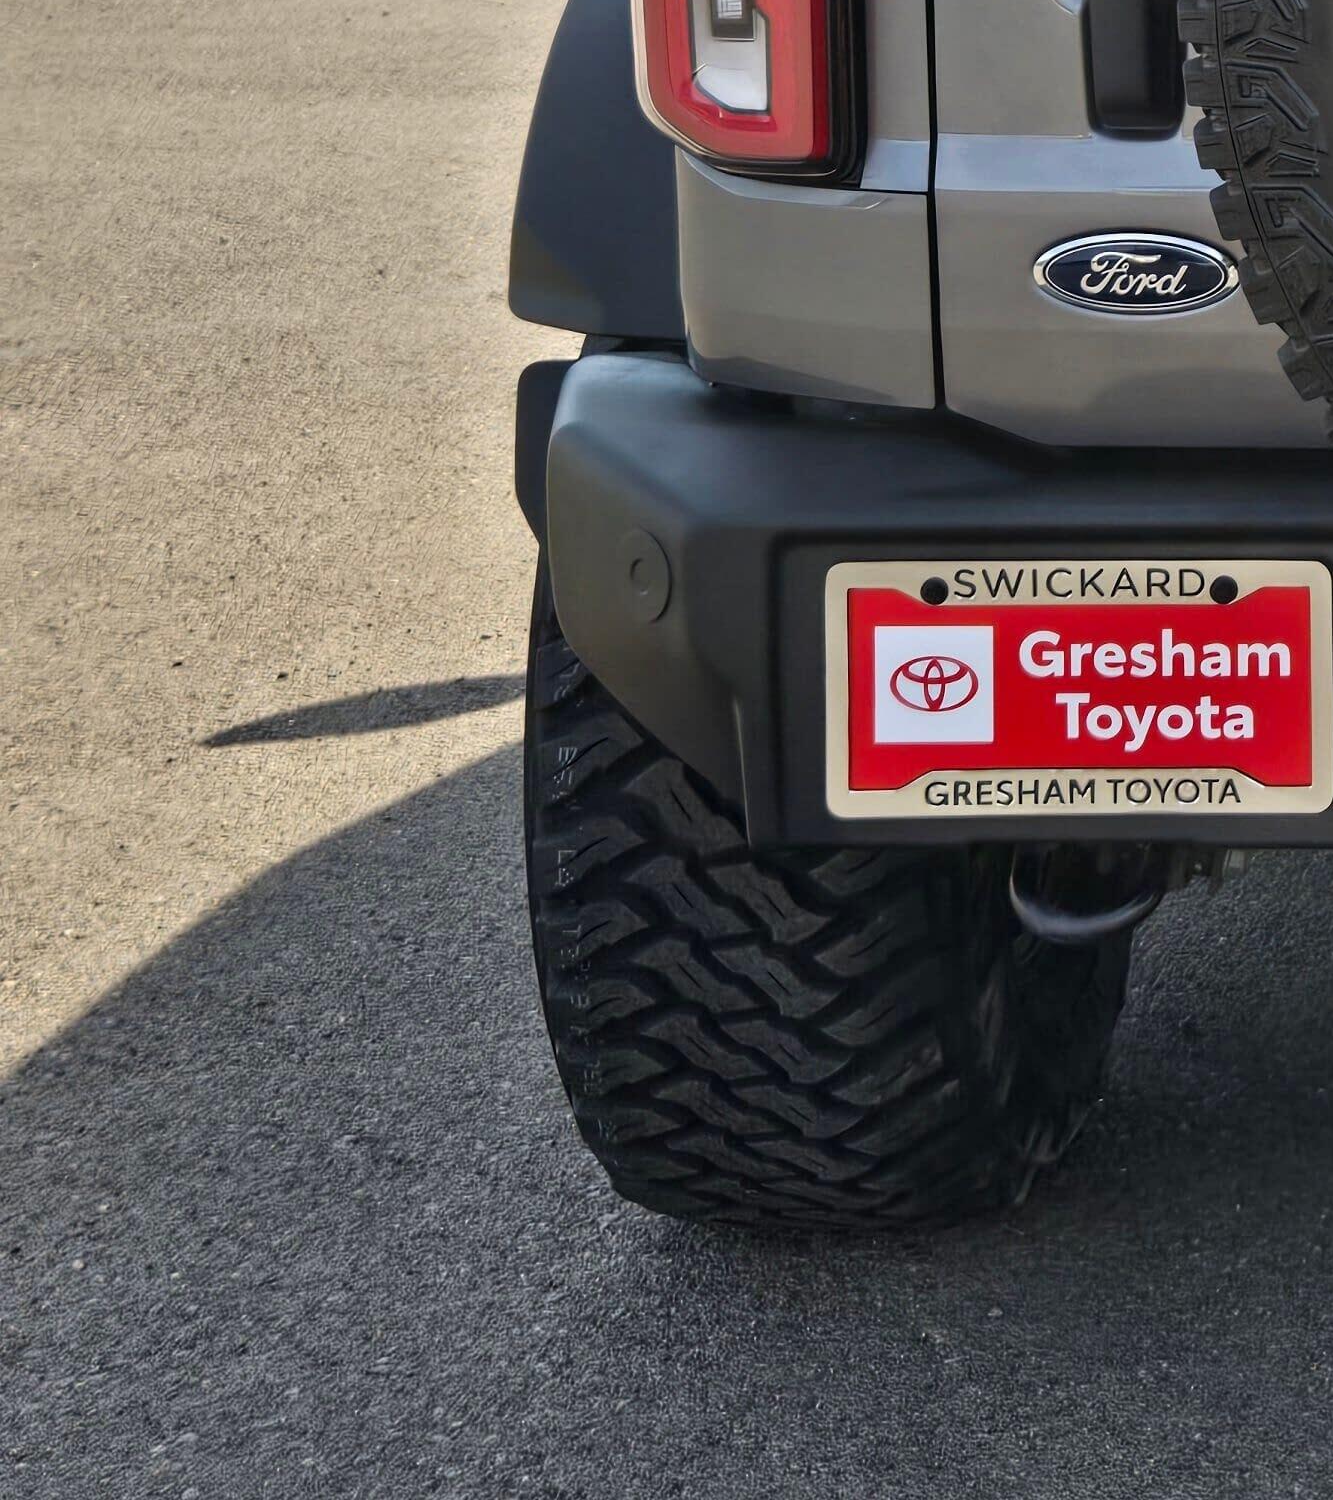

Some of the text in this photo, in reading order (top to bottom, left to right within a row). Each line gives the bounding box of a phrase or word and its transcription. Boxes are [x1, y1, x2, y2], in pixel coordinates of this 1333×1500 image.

[1080, 251, 1189, 296] Ford
[953, 567, 1206, 600] SWICKARD
[1018, 628, 1292, 678] Gresham
[1055, 692, 1255, 754] Toyota
[924, 776, 1241, 807] GRESHAM TOYOTA
